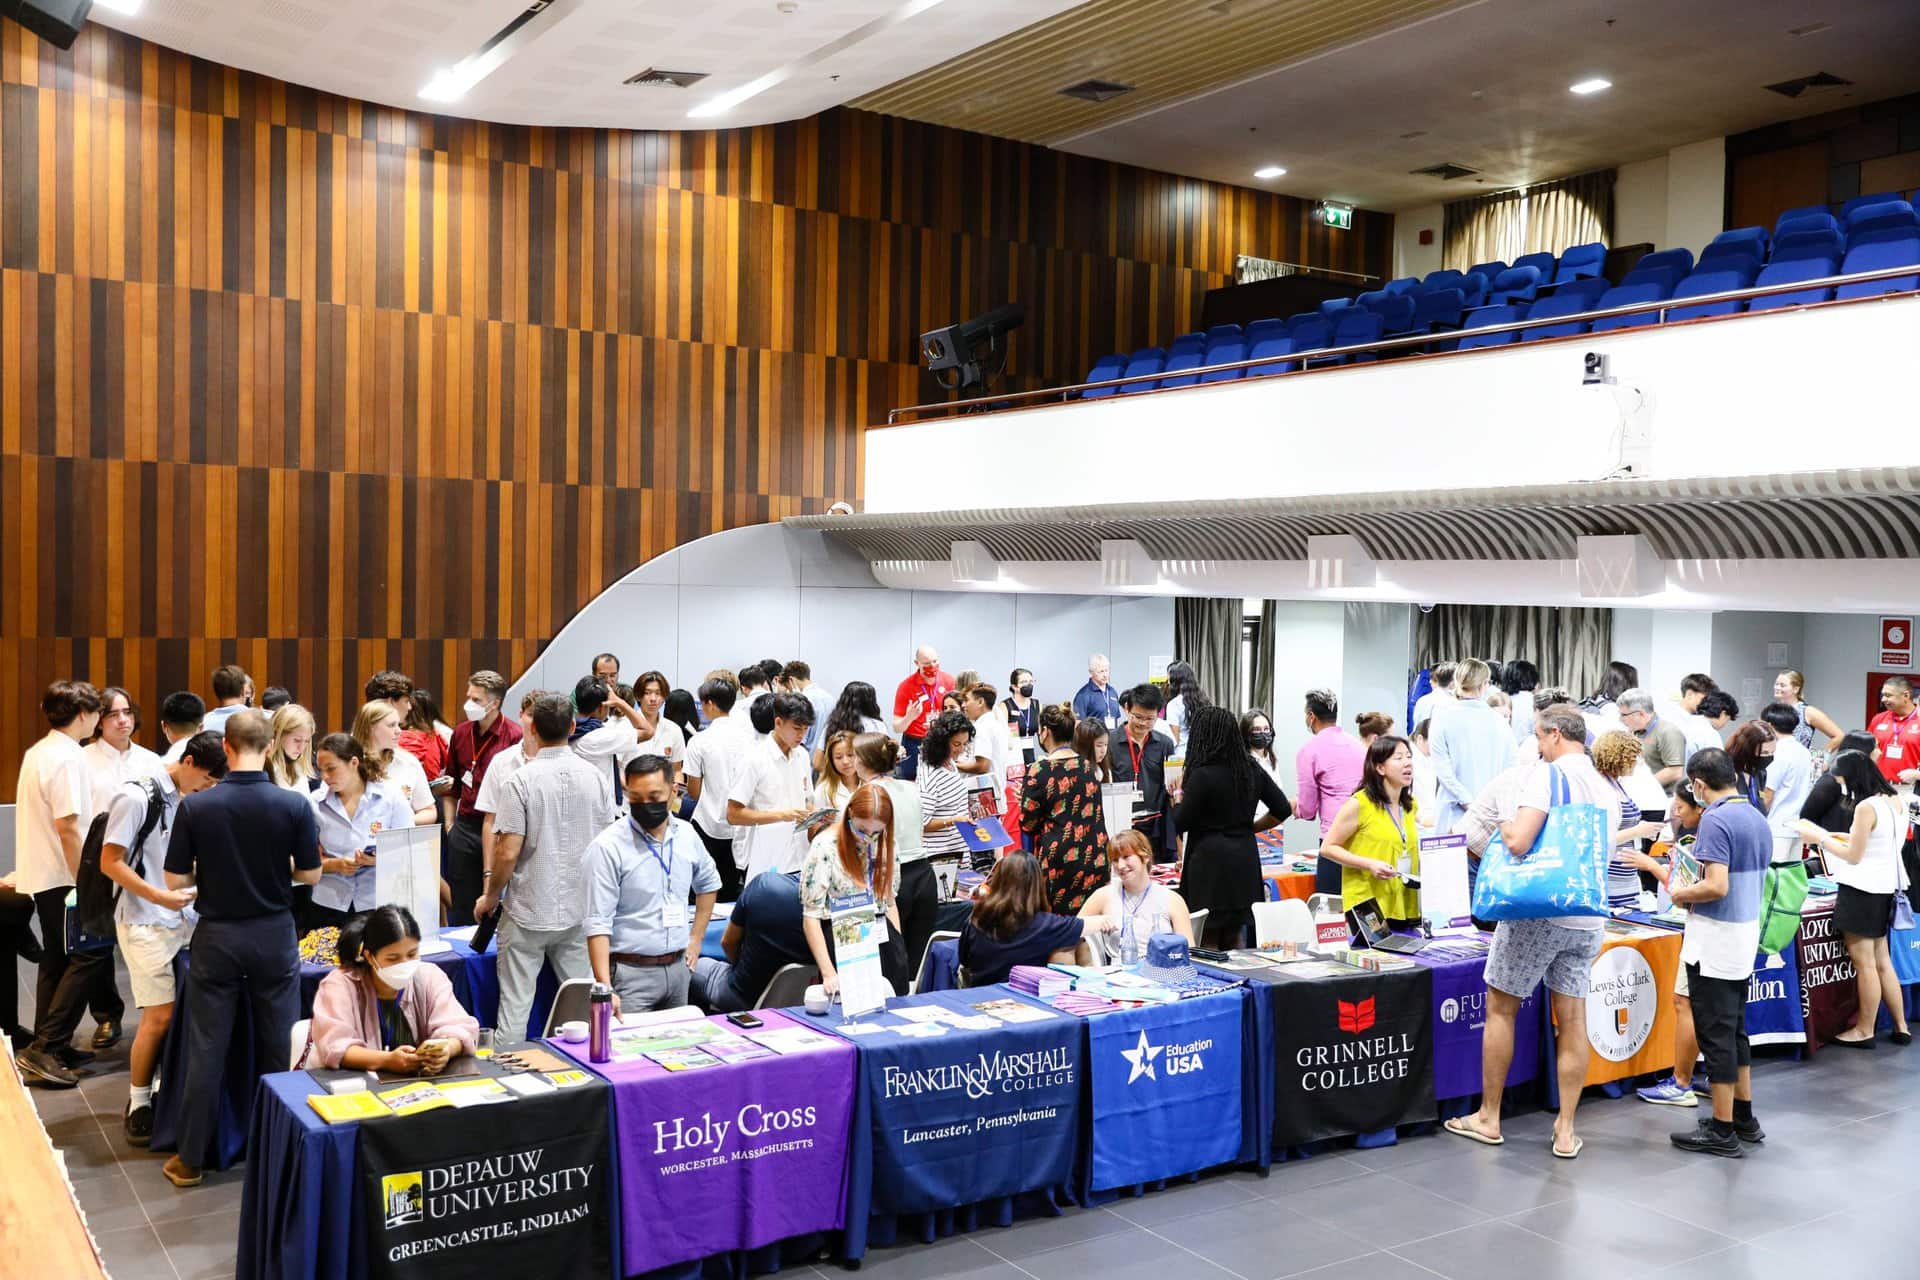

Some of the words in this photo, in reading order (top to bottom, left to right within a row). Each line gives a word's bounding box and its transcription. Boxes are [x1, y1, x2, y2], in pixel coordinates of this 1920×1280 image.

[1588, 976, 1615, 993] Lewis
[1616, 975, 1626, 989] &
[1626, 969, 1650, 987] Clark
[1604, 990, 1638, 1007] College
[1166, 1039, 1213, 1057] Education
[1166, 1053, 1204, 1076] USA
[1296, 1033, 1415, 1067] GRINNELL
[1002, 1071, 1074, 1093] COLLEGE
[1302, 1058, 1409, 1091] COLLEGE
[652, 1112, 731, 1154] Holy
[737, 1103, 817, 1137] Cross
[903, 1123, 972, 1144] Lancaster,
[976, 1107, 1057, 1131] Pennsylvania
[428, 1149, 544, 1192] DEPAUW
[660, 1155, 728, 1176] WORCESTER,
[731, 1138, 814, 1161] MASSACHUSETTS
[429, 1164, 594, 1218] UNIVERSITY
[388, 1221, 518, 1262] GREENCASTLE,
[521, 1202, 590, 1232] INDIANA
